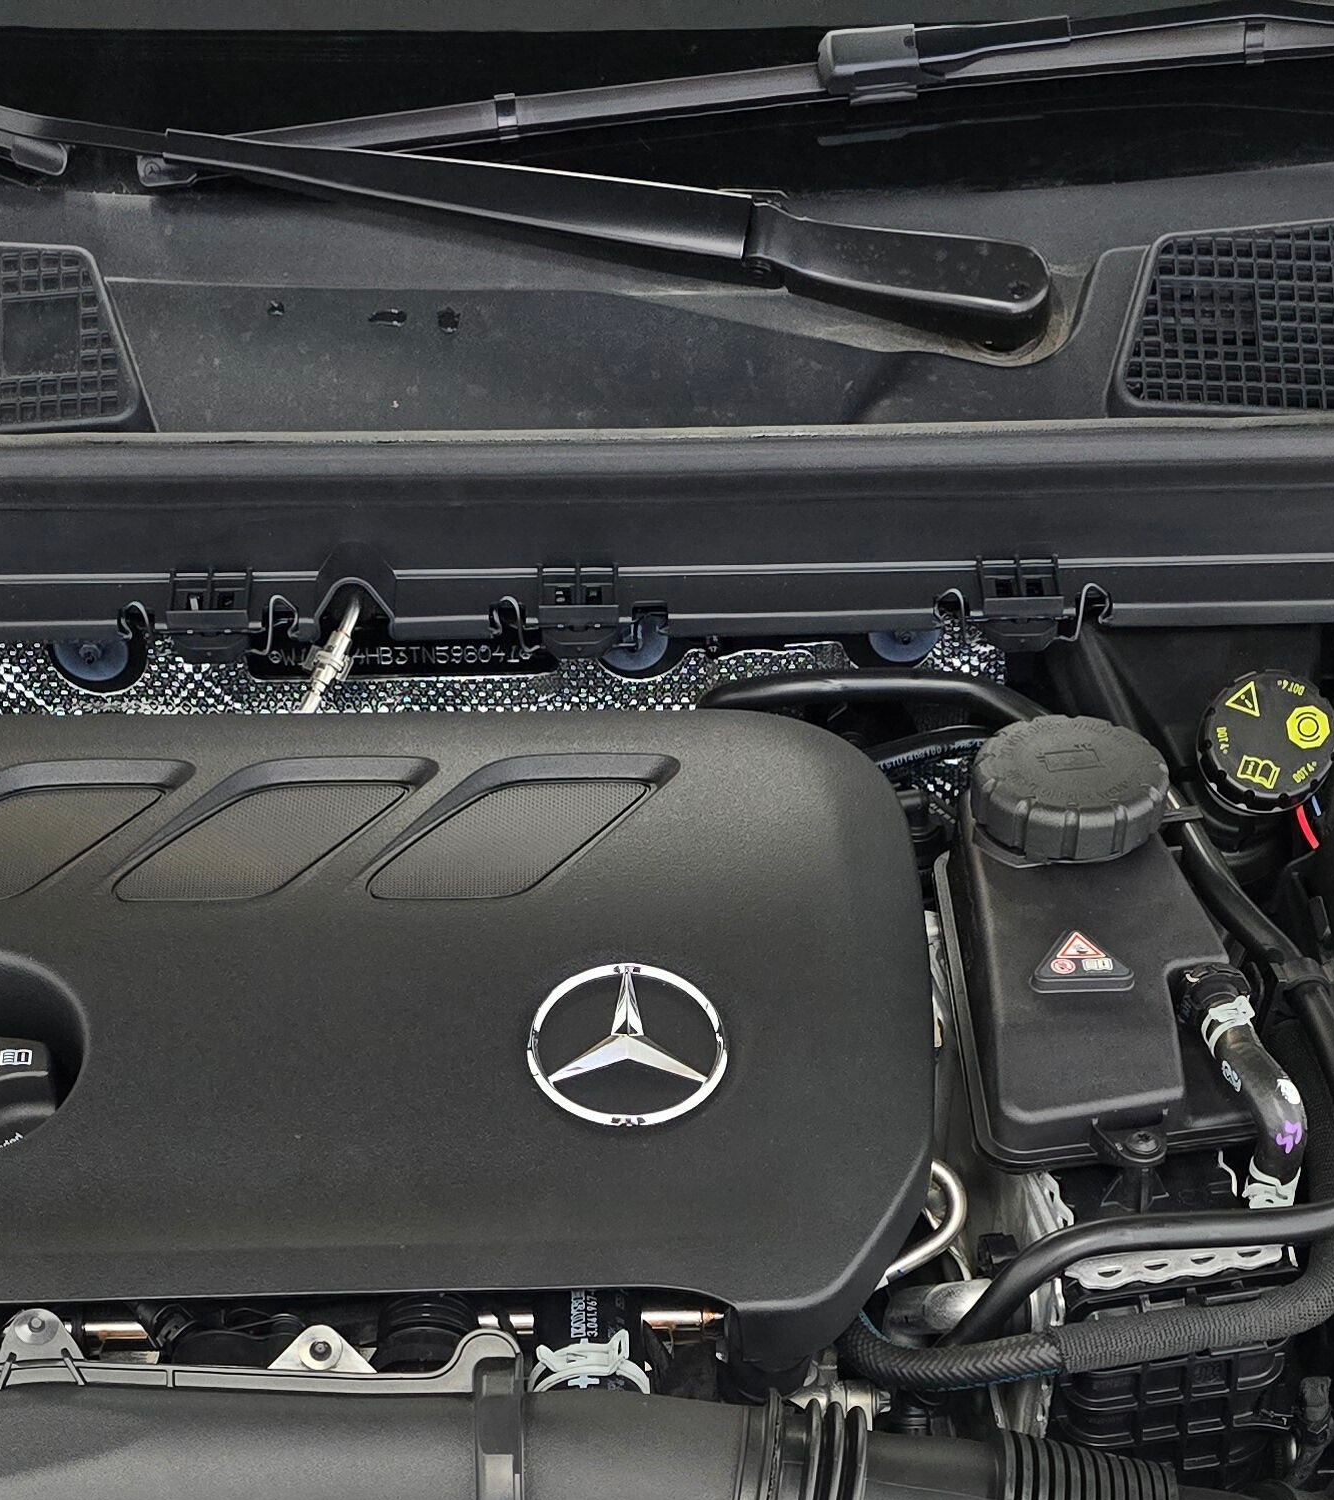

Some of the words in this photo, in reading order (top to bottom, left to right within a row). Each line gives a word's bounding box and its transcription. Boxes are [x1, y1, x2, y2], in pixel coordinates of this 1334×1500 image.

[281, 644, 520, 666] W14HB3TN596041
[1289, 682, 1305, 696] DOT
[1216, 726, 1229, 744] DOT
[1292, 769, 1308, 784] DOT
[571, 1289, 587, 1339] KAYSE
